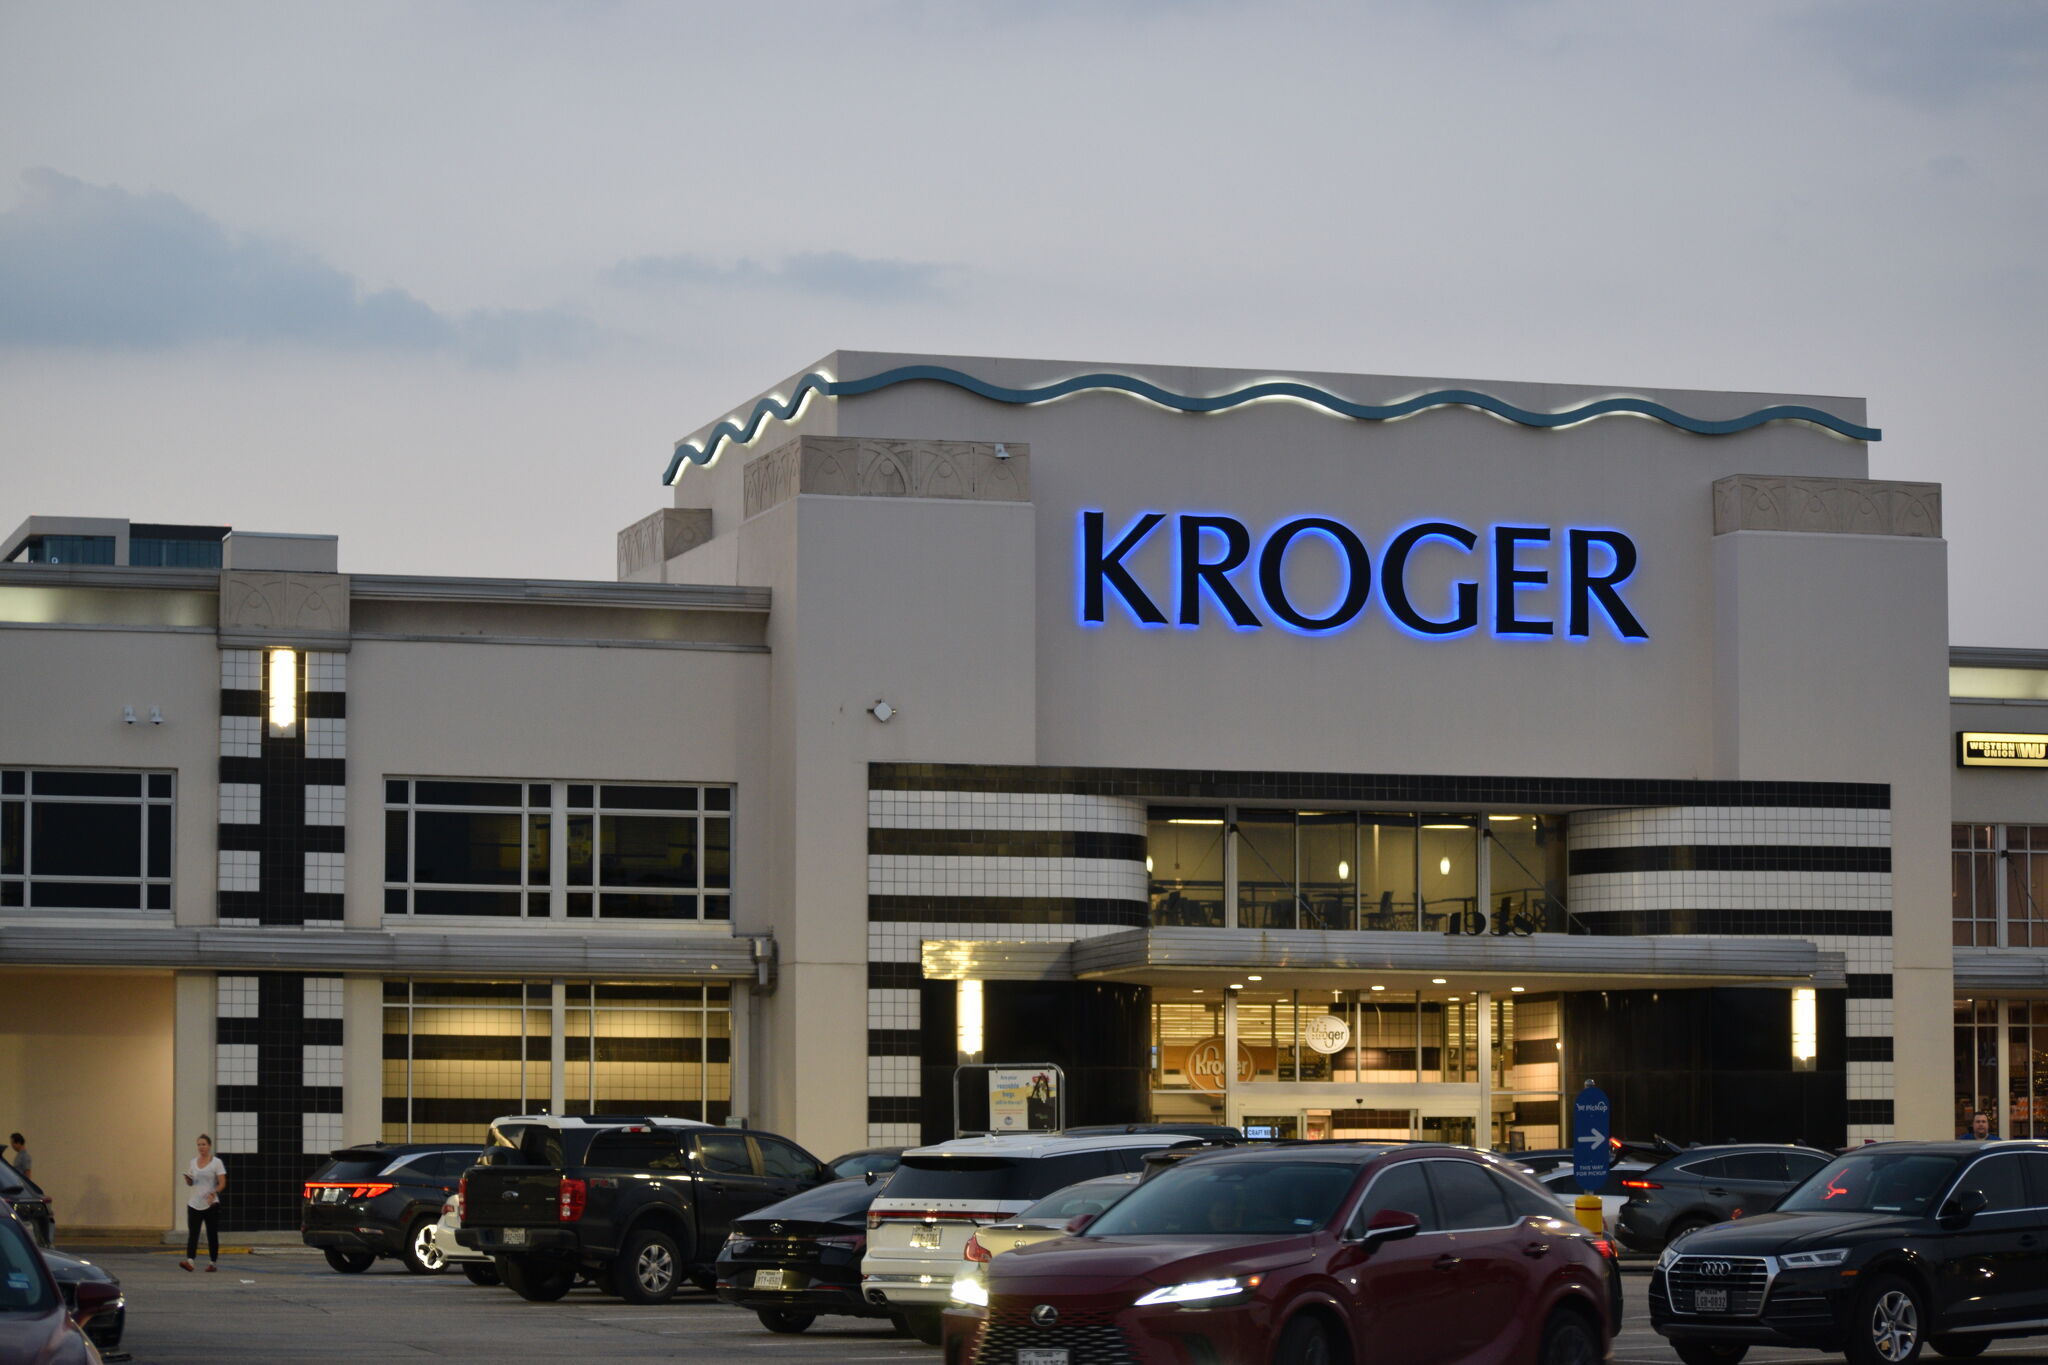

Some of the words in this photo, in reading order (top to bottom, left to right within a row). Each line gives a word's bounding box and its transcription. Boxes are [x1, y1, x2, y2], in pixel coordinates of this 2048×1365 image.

[1083, 511, 1650, 640] KROGER
[1969, 741, 2015, 750] WESTERN
[1983, 750, 2015, 758] UNION
[1195, 1045, 1249, 1088] Kroer
